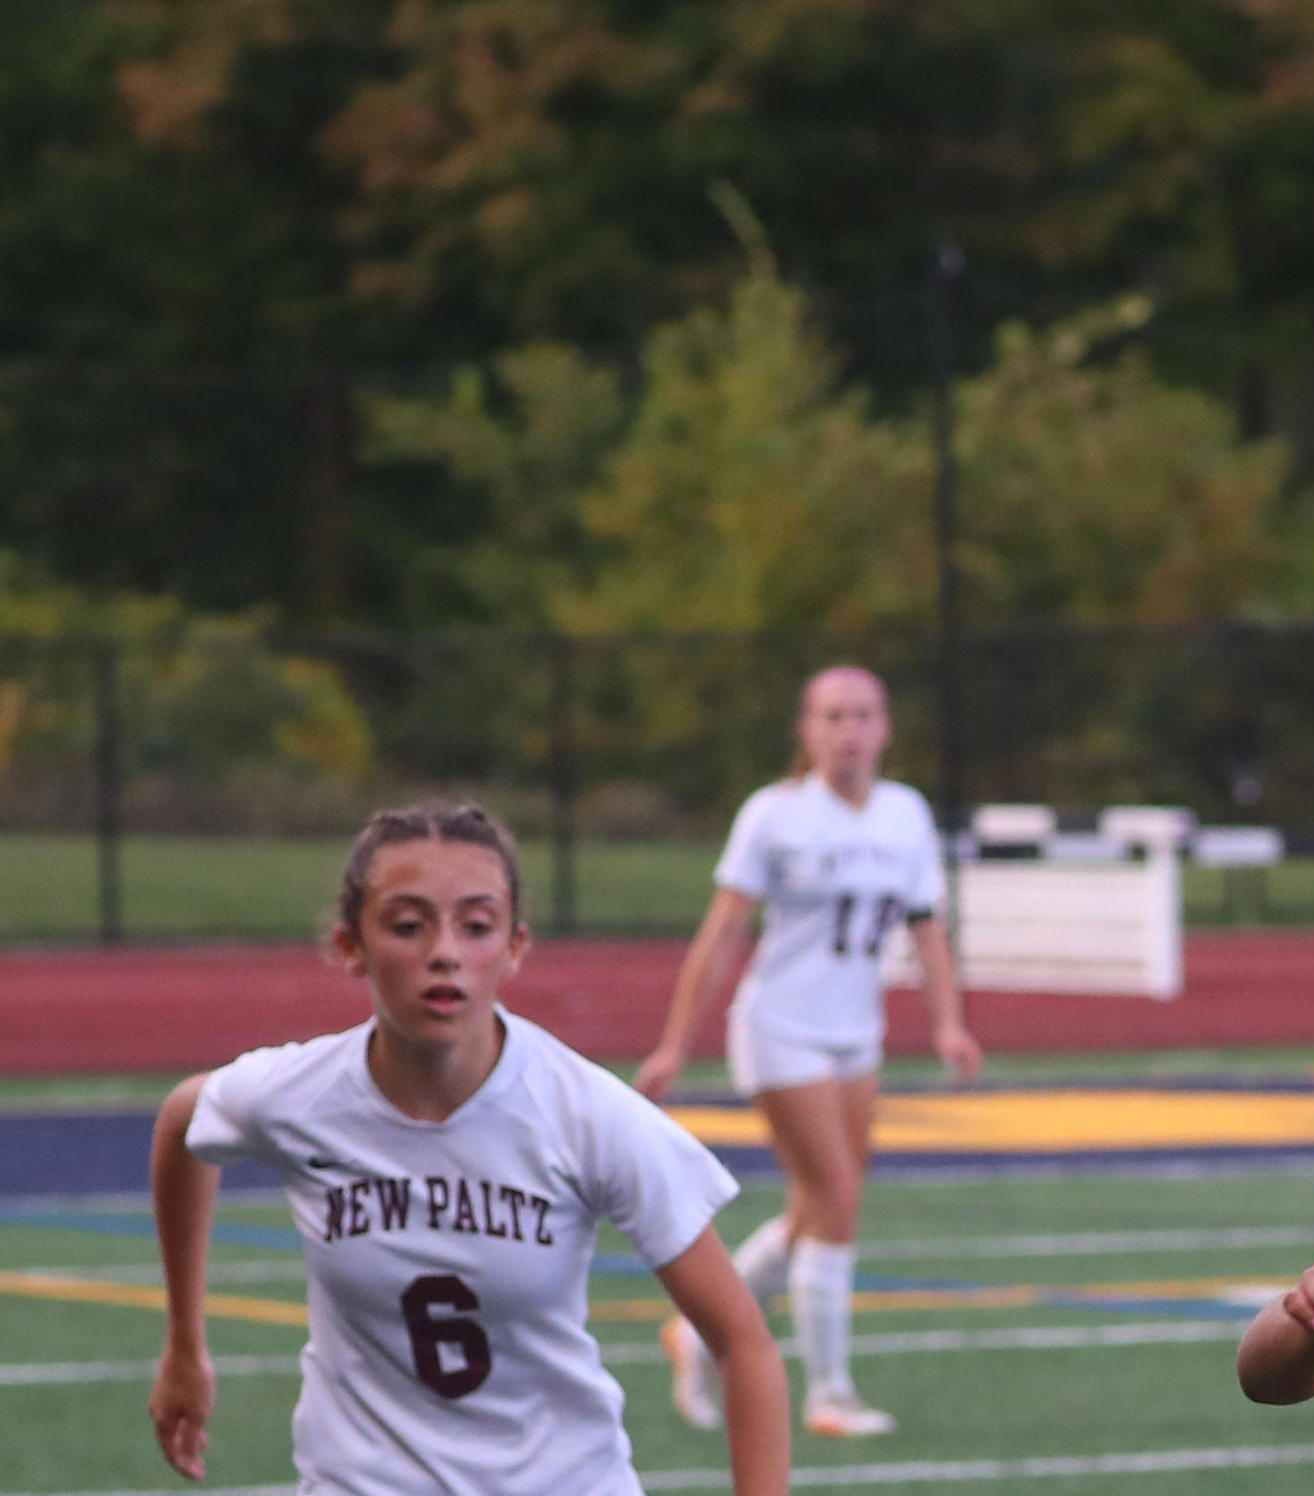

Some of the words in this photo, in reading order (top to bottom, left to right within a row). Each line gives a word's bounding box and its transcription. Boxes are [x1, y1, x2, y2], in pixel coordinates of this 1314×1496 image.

[325, 1178, 411, 1243] NEW
[425, 1176, 554, 1246] PALTZ
[400, 1275, 493, 1400] 6
